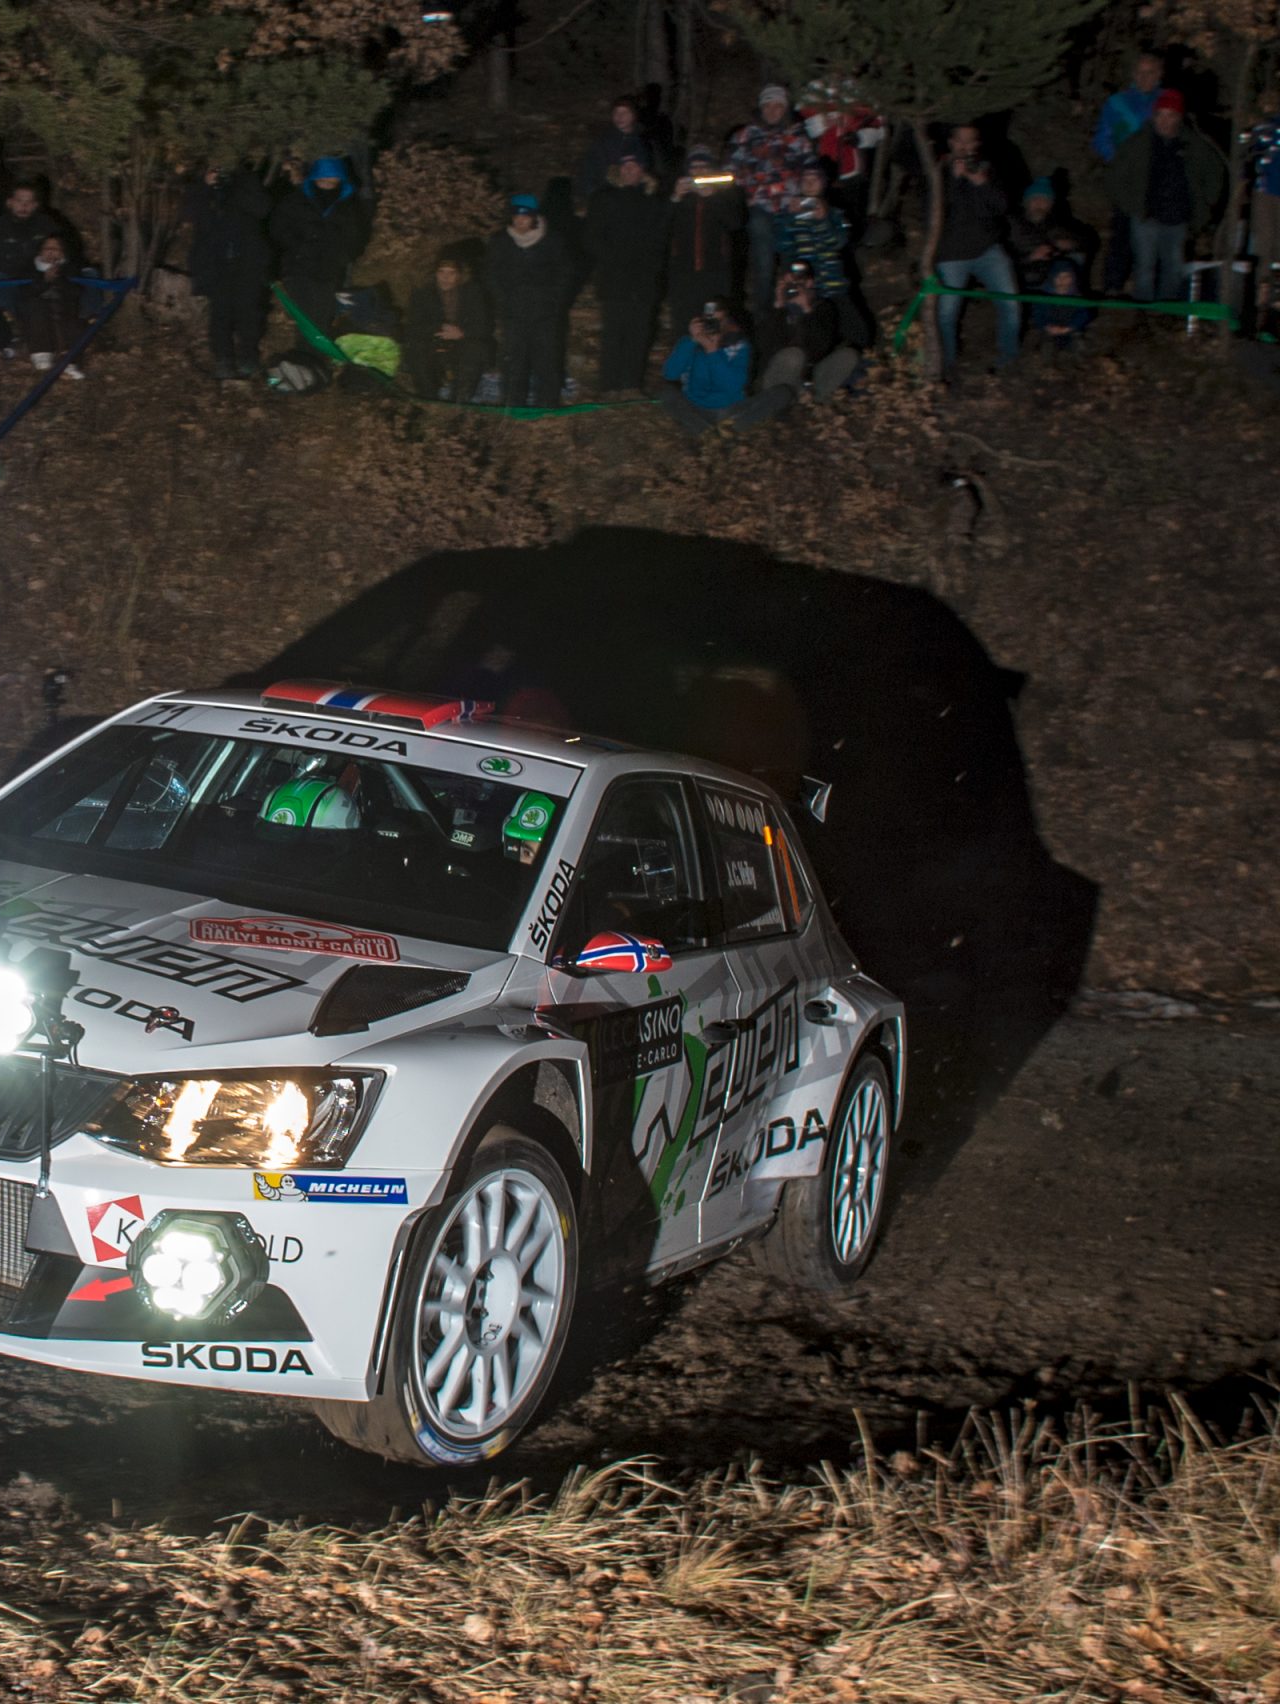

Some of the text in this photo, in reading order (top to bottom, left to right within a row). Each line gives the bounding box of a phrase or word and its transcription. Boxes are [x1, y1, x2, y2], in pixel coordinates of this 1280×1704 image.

[135, 704, 194, 725] 71
[238, 717, 408, 757] ŠKODA
[451, 831, 475, 845] OMP
[528, 858, 577, 953] ŠKODA
[201, 926, 261, 944] RALLYE
[65, 985, 195, 1043] ODA
[308, 1182, 405, 1194] MICHELIN
